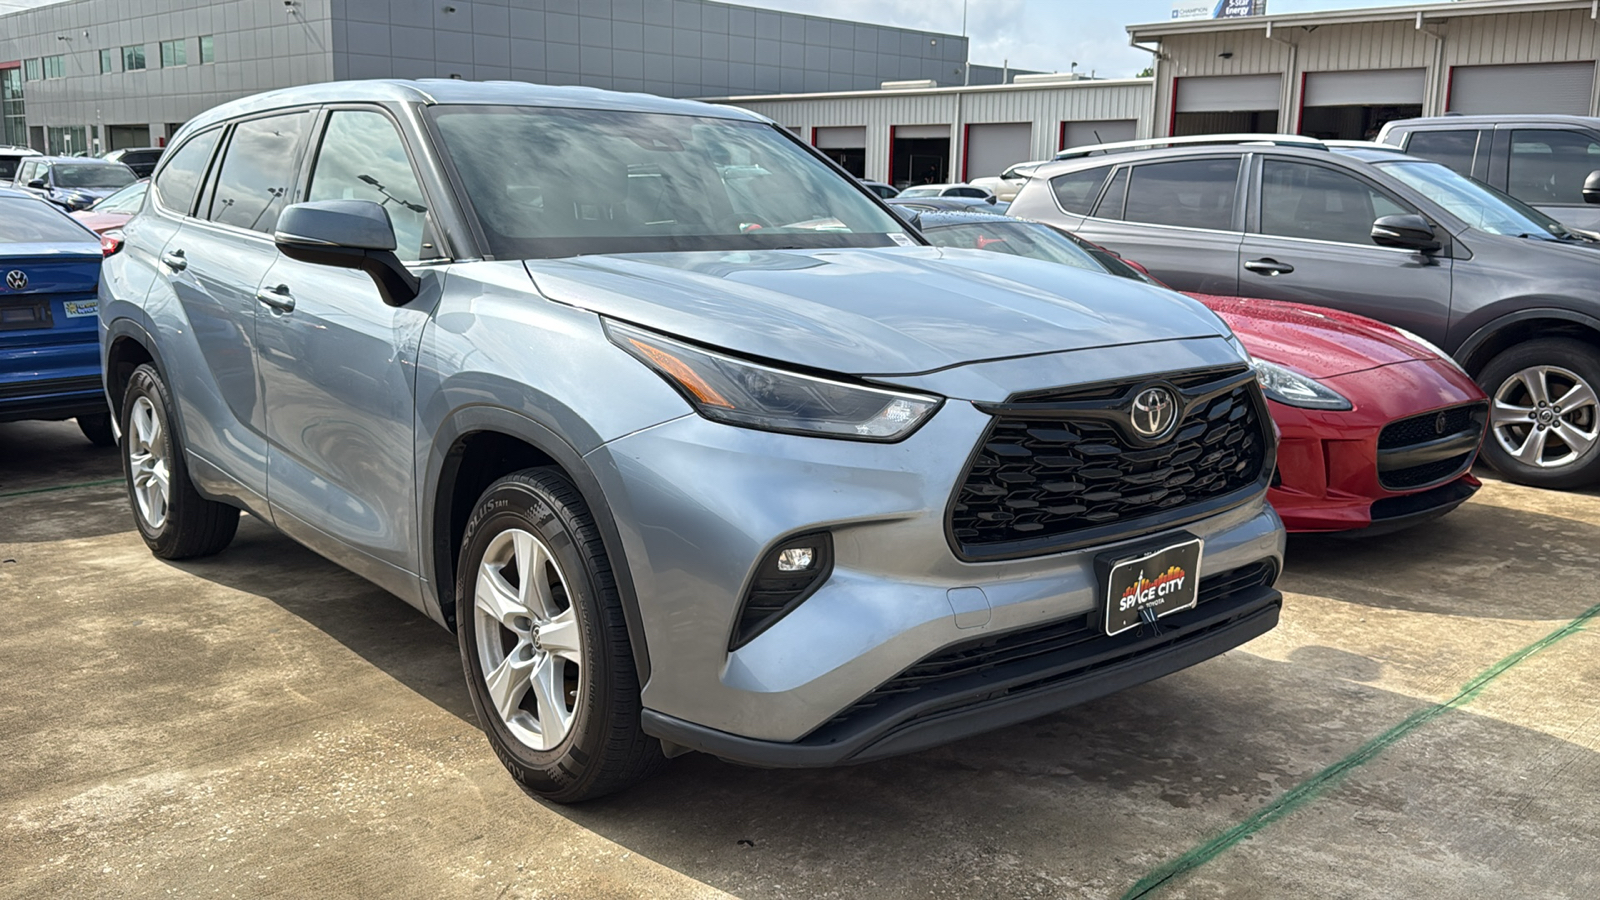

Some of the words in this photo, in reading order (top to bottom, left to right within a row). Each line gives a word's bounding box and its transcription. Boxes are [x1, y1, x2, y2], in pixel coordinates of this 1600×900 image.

[1225, 6, 1249, 15] Energy
[463, 498, 494, 550] SOLUS
[1119, 583, 1156, 611] SPACE
[1157, 576, 1185, 596] CITY
[1145, 598, 1165, 608] TOYOTA
